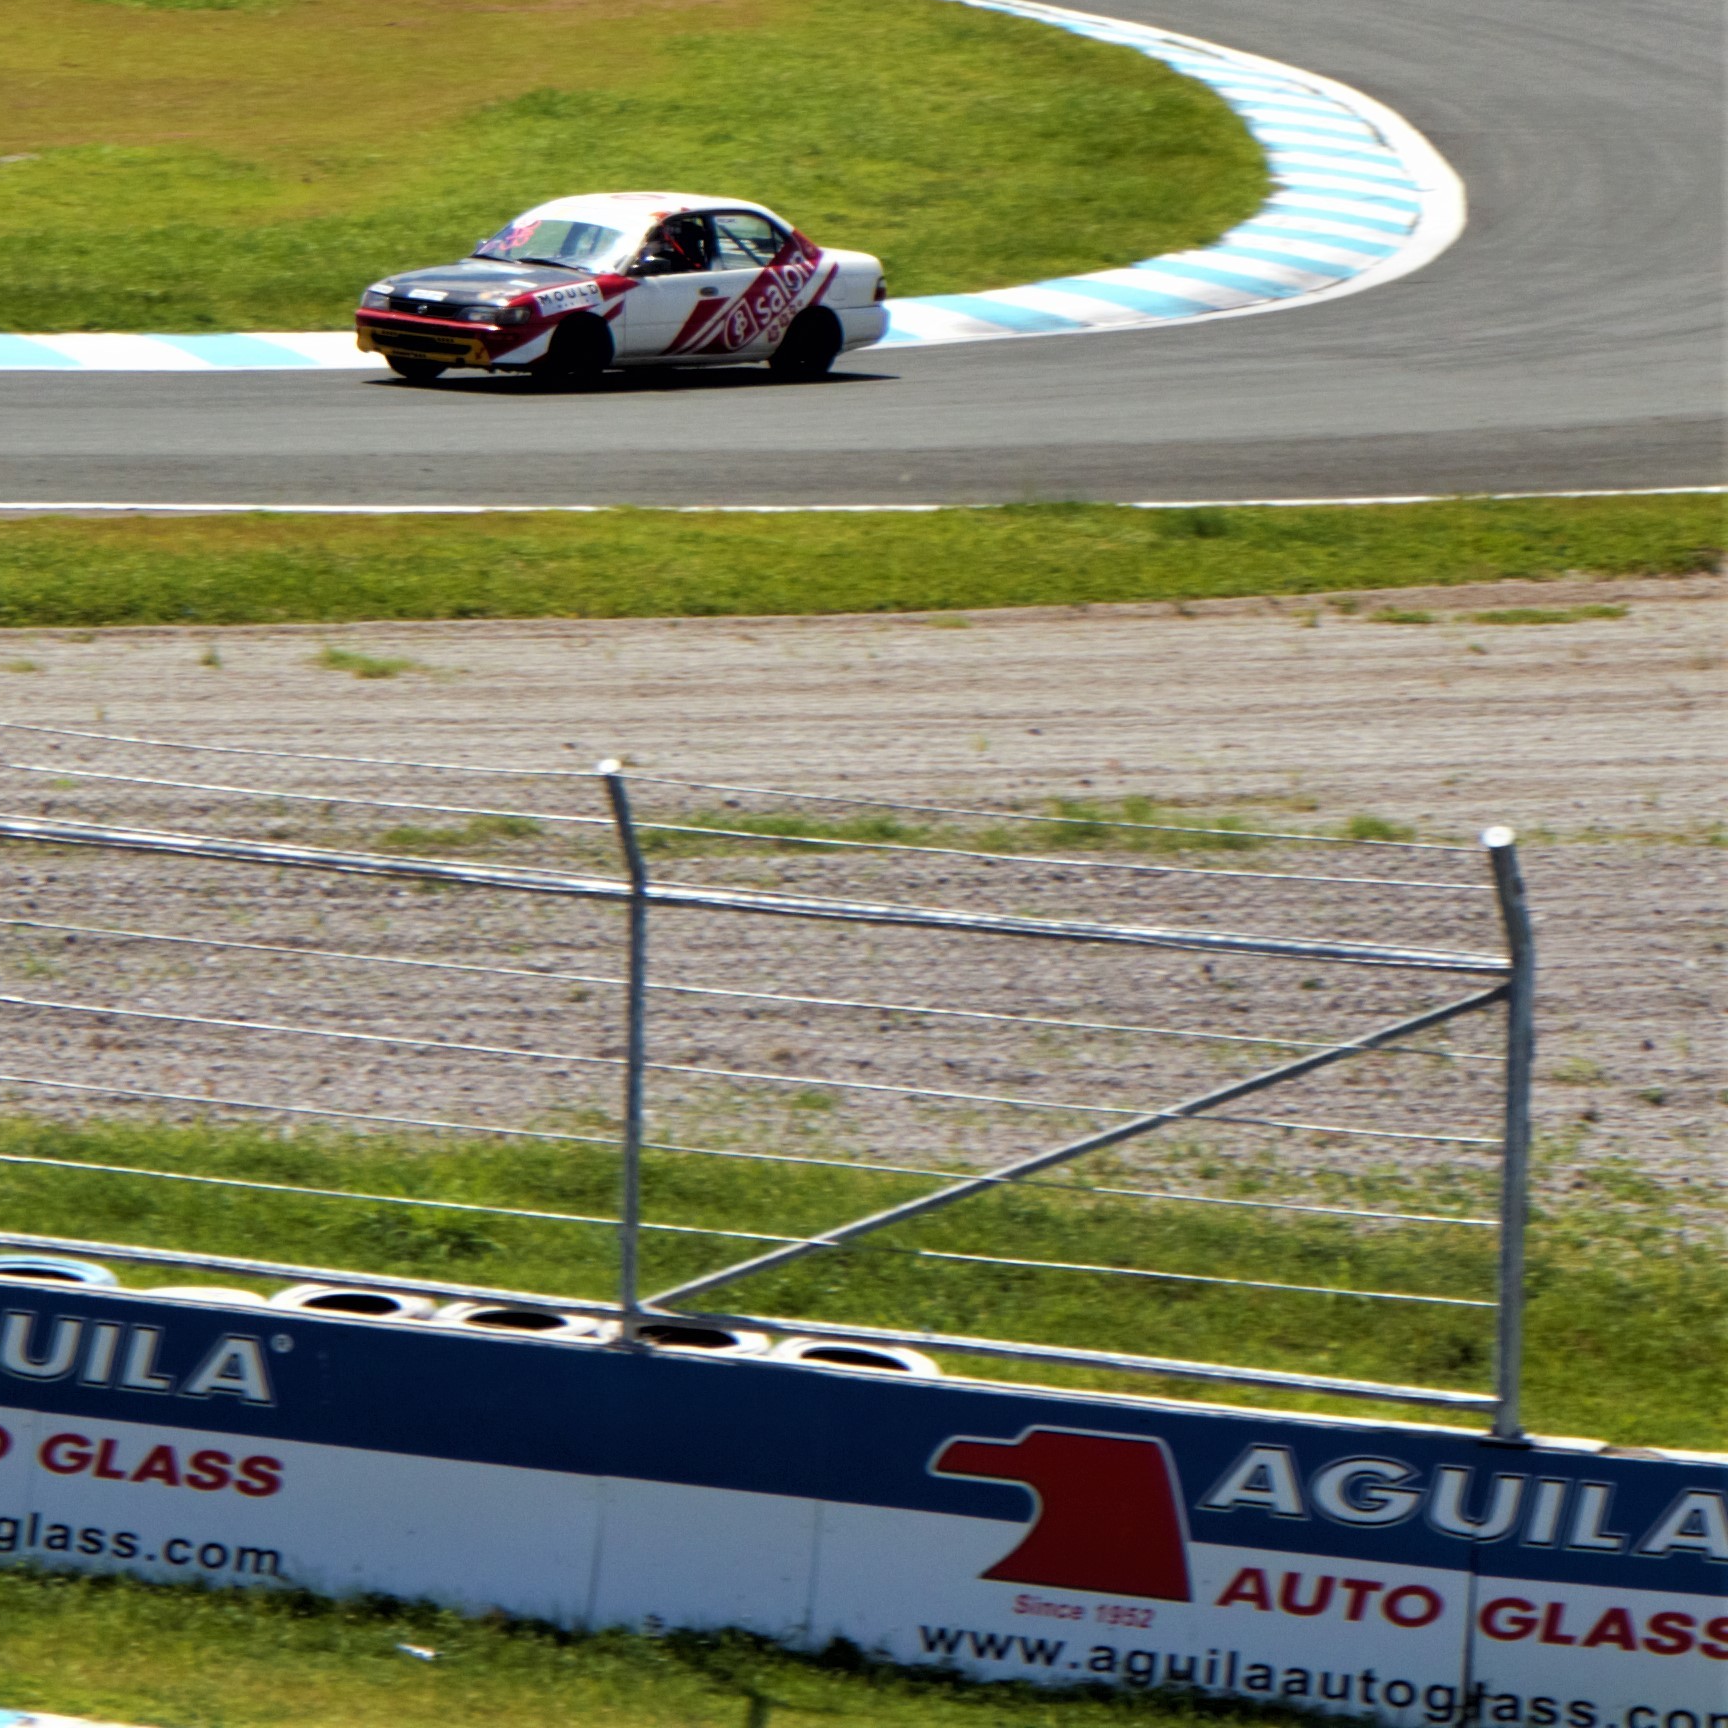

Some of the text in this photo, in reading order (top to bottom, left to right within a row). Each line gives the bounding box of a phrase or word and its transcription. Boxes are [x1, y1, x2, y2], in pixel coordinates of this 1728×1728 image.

[37, 1432, 285, 1499] GLASS
[1196, 1441, 1728, 1564] AGUILA
[1011, 1592, 1157, 1630] Since 1952
[1215, 1566, 1445, 1629] AUTO
